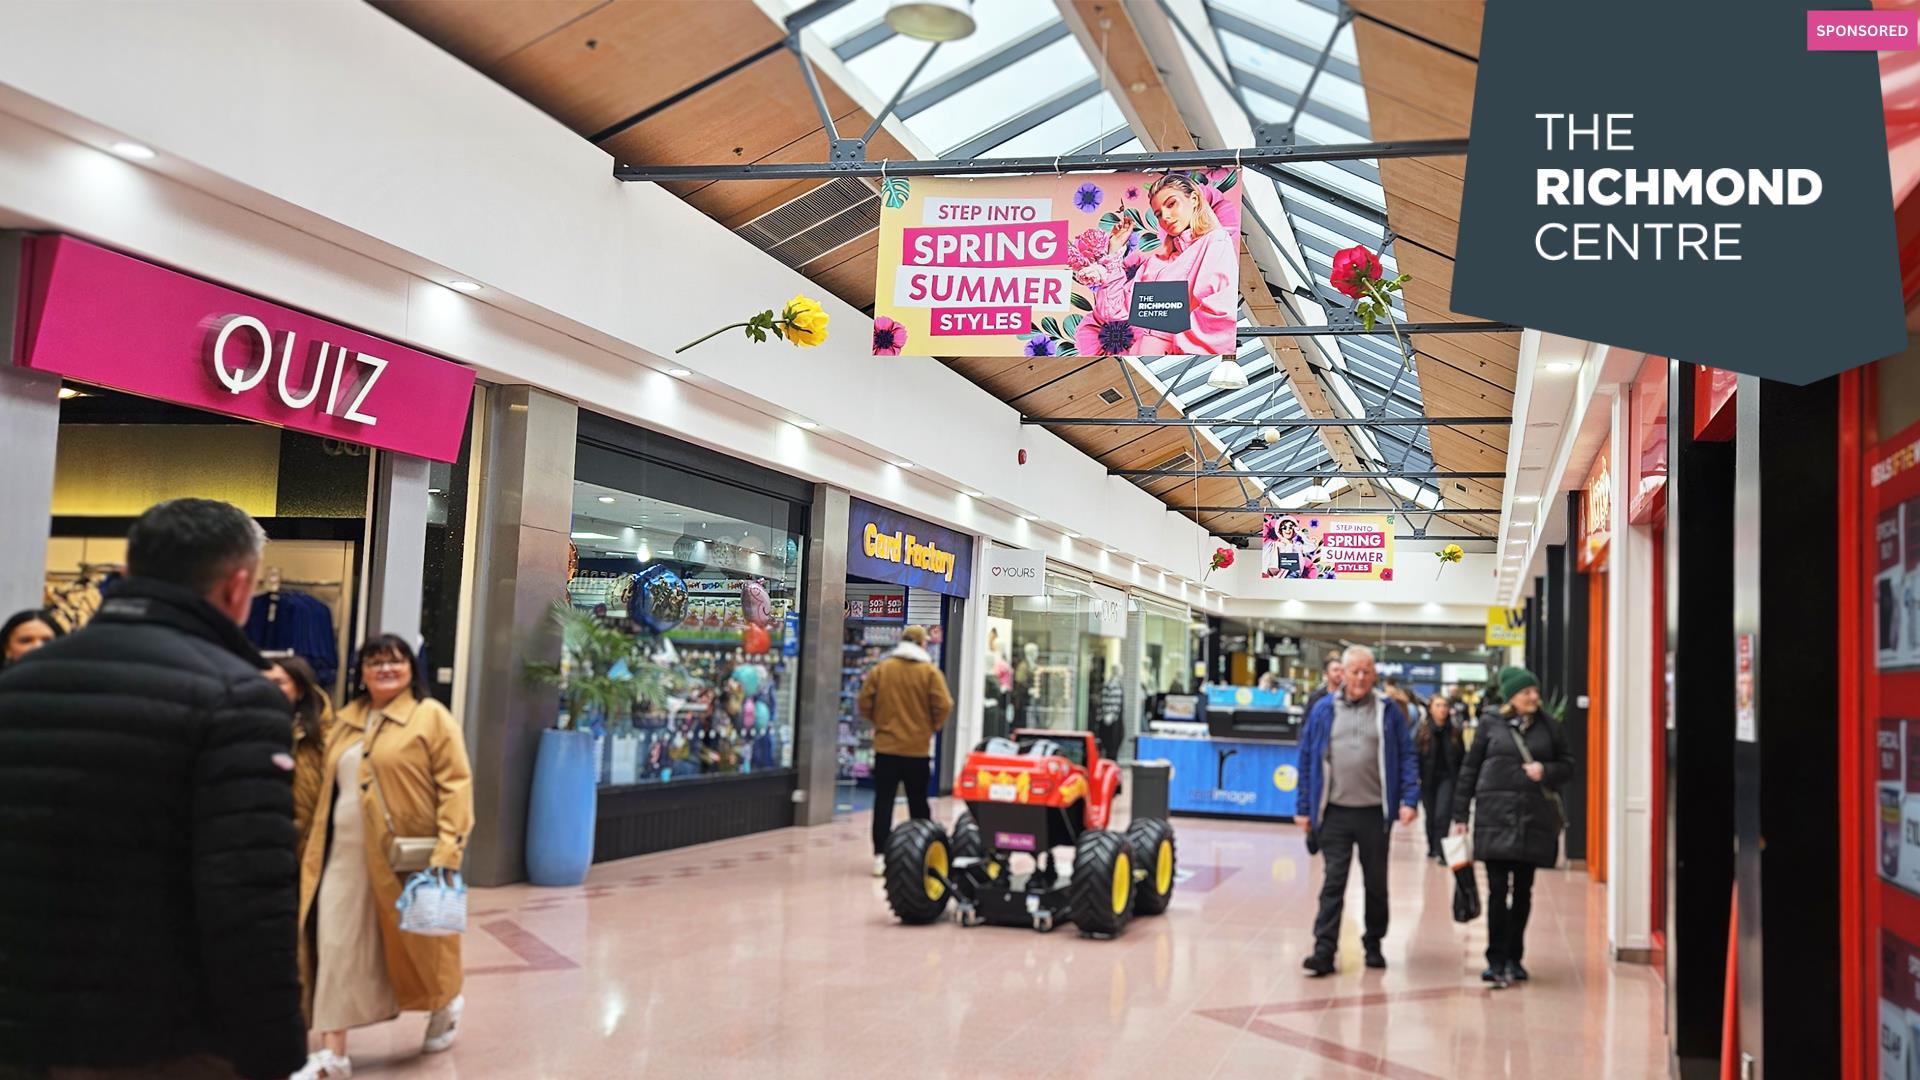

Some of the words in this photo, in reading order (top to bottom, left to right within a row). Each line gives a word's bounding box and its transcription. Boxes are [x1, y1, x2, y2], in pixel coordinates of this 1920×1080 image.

[938, 204, 982, 221] STEP
[988, 205, 1036, 221] INTO
[913, 229, 1058, 265] SPRING
[909, 273, 1062, 305] SUMMER
[1138, 302, 1183, 310] RICHMOND
[940, 311, 1022, 331] STYLES
[1138, 310, 1168, 318] CENTRE
[212, 314, 389, 427] QUIZ
[1327, 534, 1382, 547] SPRING
[863, 522, 902, 563] Card
[903, 533, 956, 583] Factory
[1326, 549, 1383, 562] SUMMER
[1003, 567, 1035, 578] YOURS
[1337, 563, 1369, 571] STYLES
